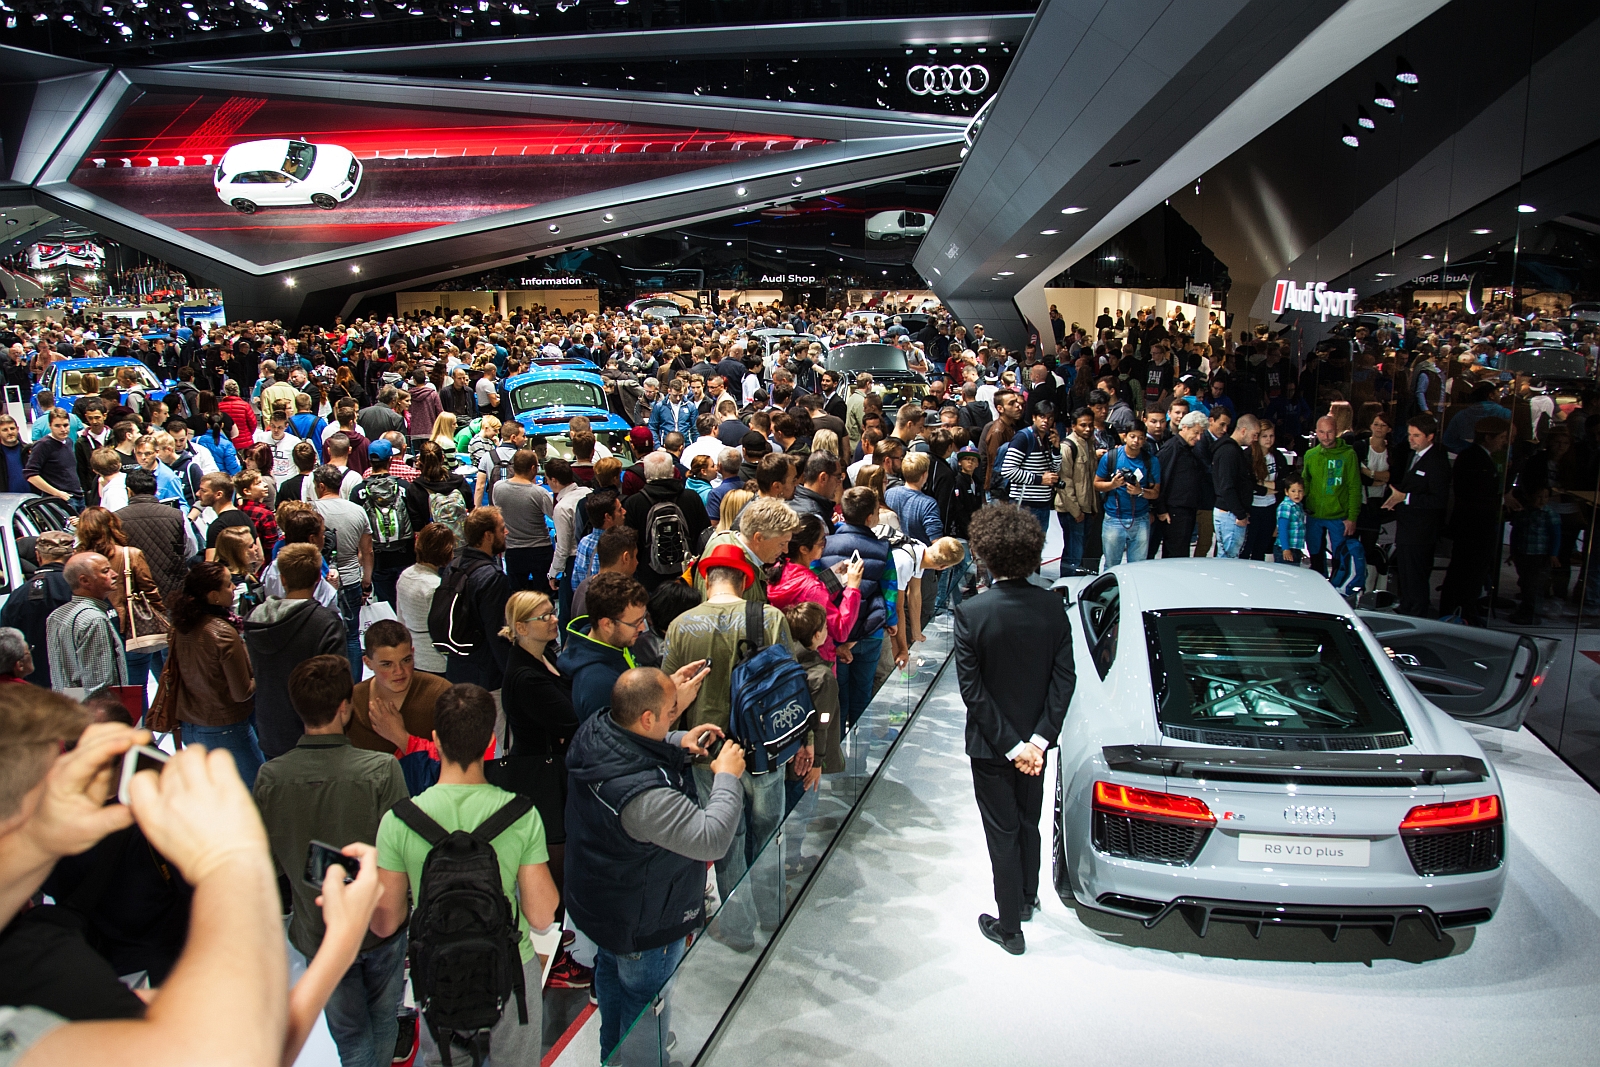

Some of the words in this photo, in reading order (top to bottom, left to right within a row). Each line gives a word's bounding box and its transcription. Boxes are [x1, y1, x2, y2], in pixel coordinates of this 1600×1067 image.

[520, 277, 582, 286] Information
[760, 274, 786, 283] Audi
[787, 274, 816, 284] Shop
[1284, 280, 1316, 312] Audi
[1313, 281, 1358, 323] Sport
[1264, 843, 1282, 854] R8
[1285, 845, 1312, 856] V10
[1316, 847, 1344, 858] plus
